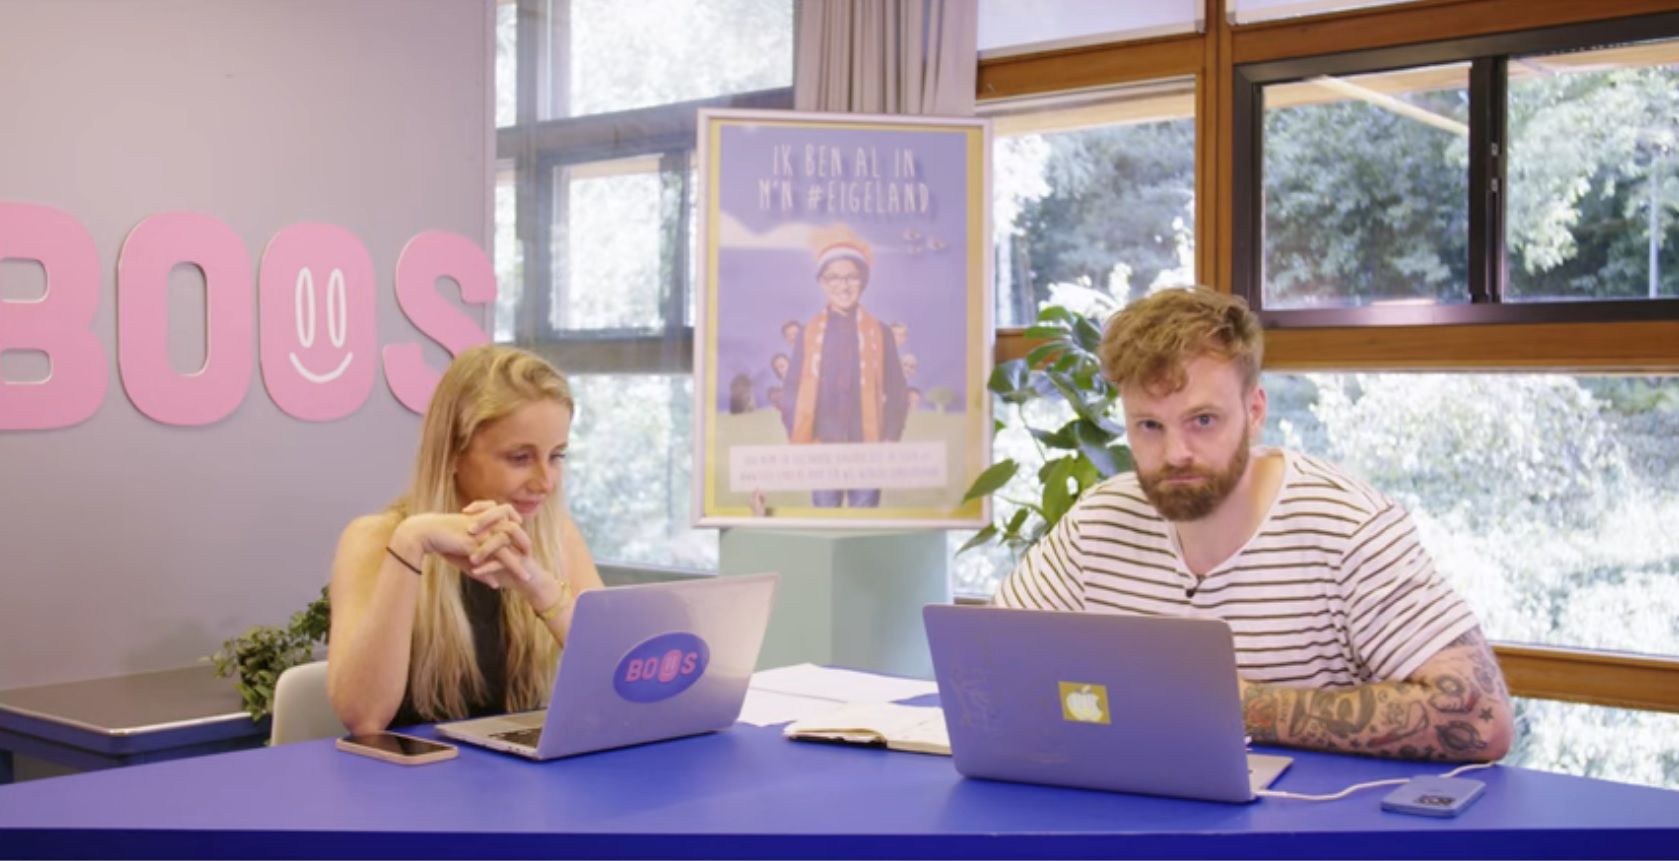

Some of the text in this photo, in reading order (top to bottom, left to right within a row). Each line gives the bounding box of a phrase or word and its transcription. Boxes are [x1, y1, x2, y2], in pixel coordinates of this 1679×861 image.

[773, 143, 916, 178] IK BEN AL IN
